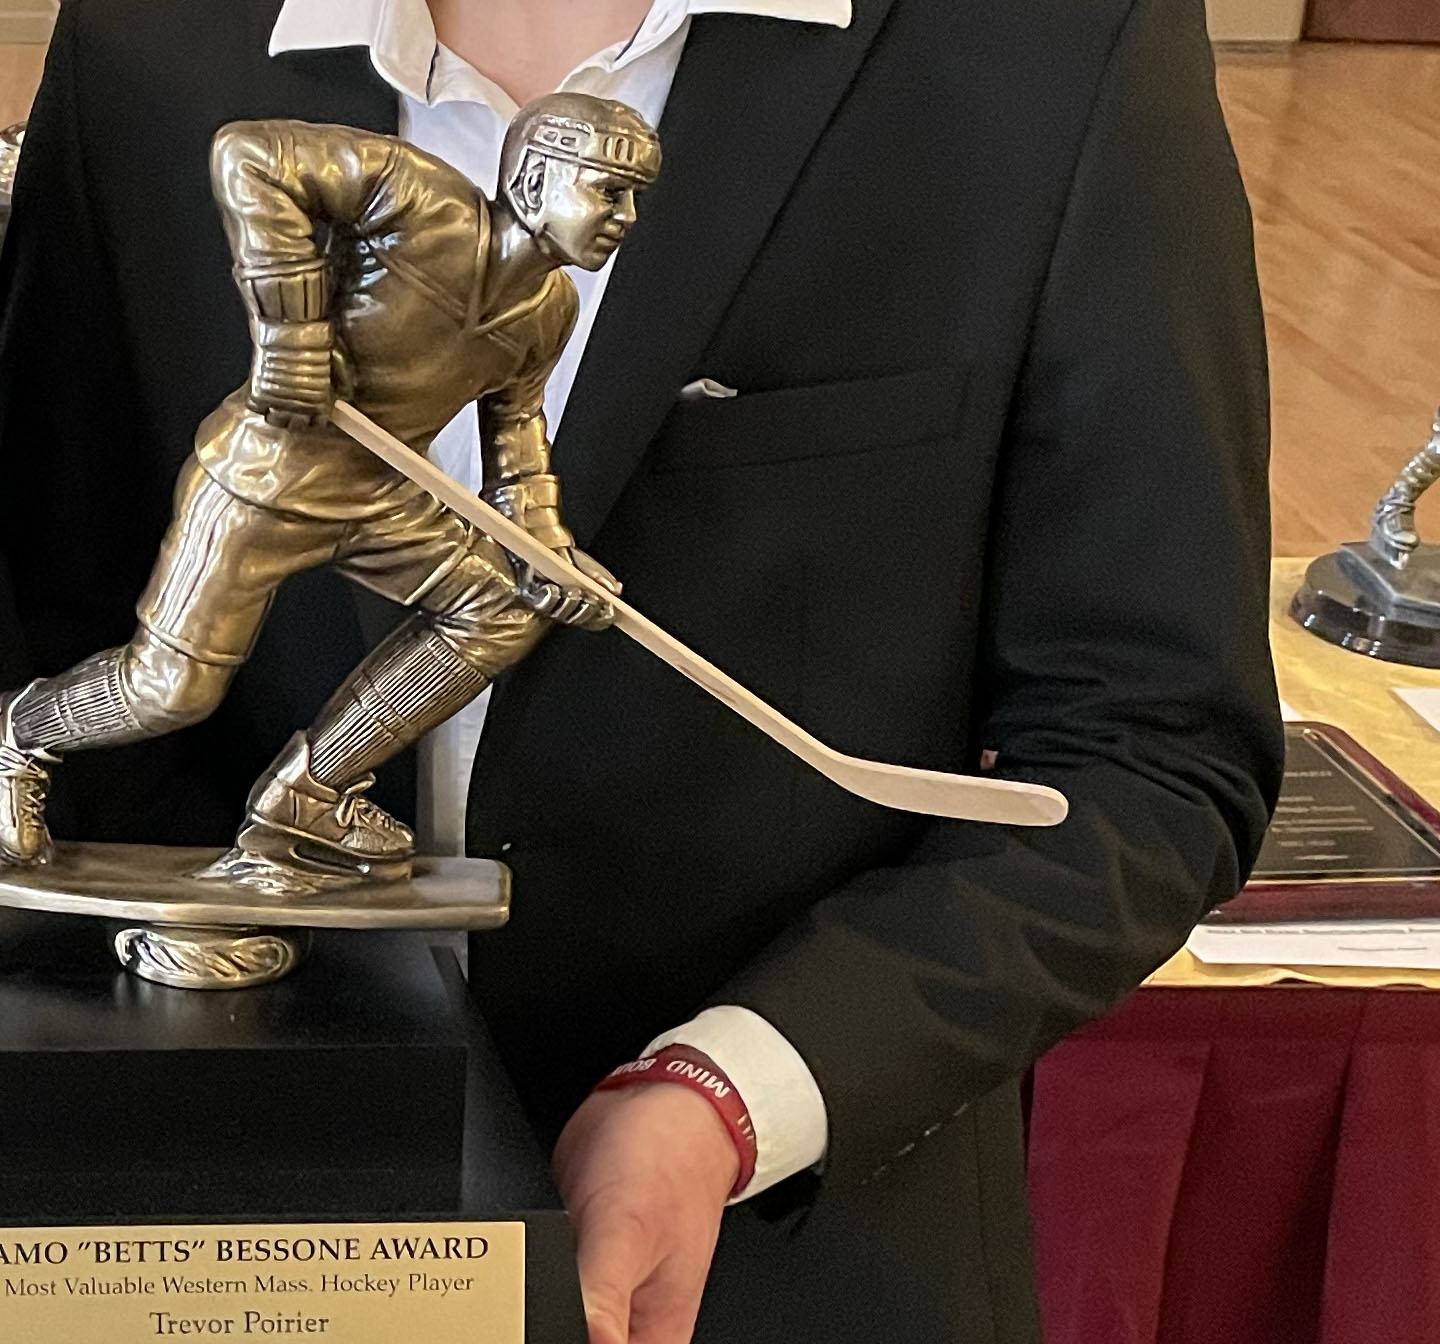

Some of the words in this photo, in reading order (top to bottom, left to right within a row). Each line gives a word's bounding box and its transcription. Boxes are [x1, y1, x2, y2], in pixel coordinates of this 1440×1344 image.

[665, 1059, 731, 1099] MIND
[77, 1239, 206, 1264] "BETTS"
[215, 1237, 361, 1262] BESSONE
[368, 1235, 489, 1261] AWARD
[4, 1277, 57, 1297] Most
[63, 1275, 155, 1296] Valuable
[162, 1274, 247, 1294] Western
[254, 1273, 313, 1294] Mass.
[320, 1272, 401, 1298] Hockey
[408, 1271, 475, 1298] Player
[148, 1311, 235, 1335] Trevor
[243, 1310, 330, 1334] Poirier
